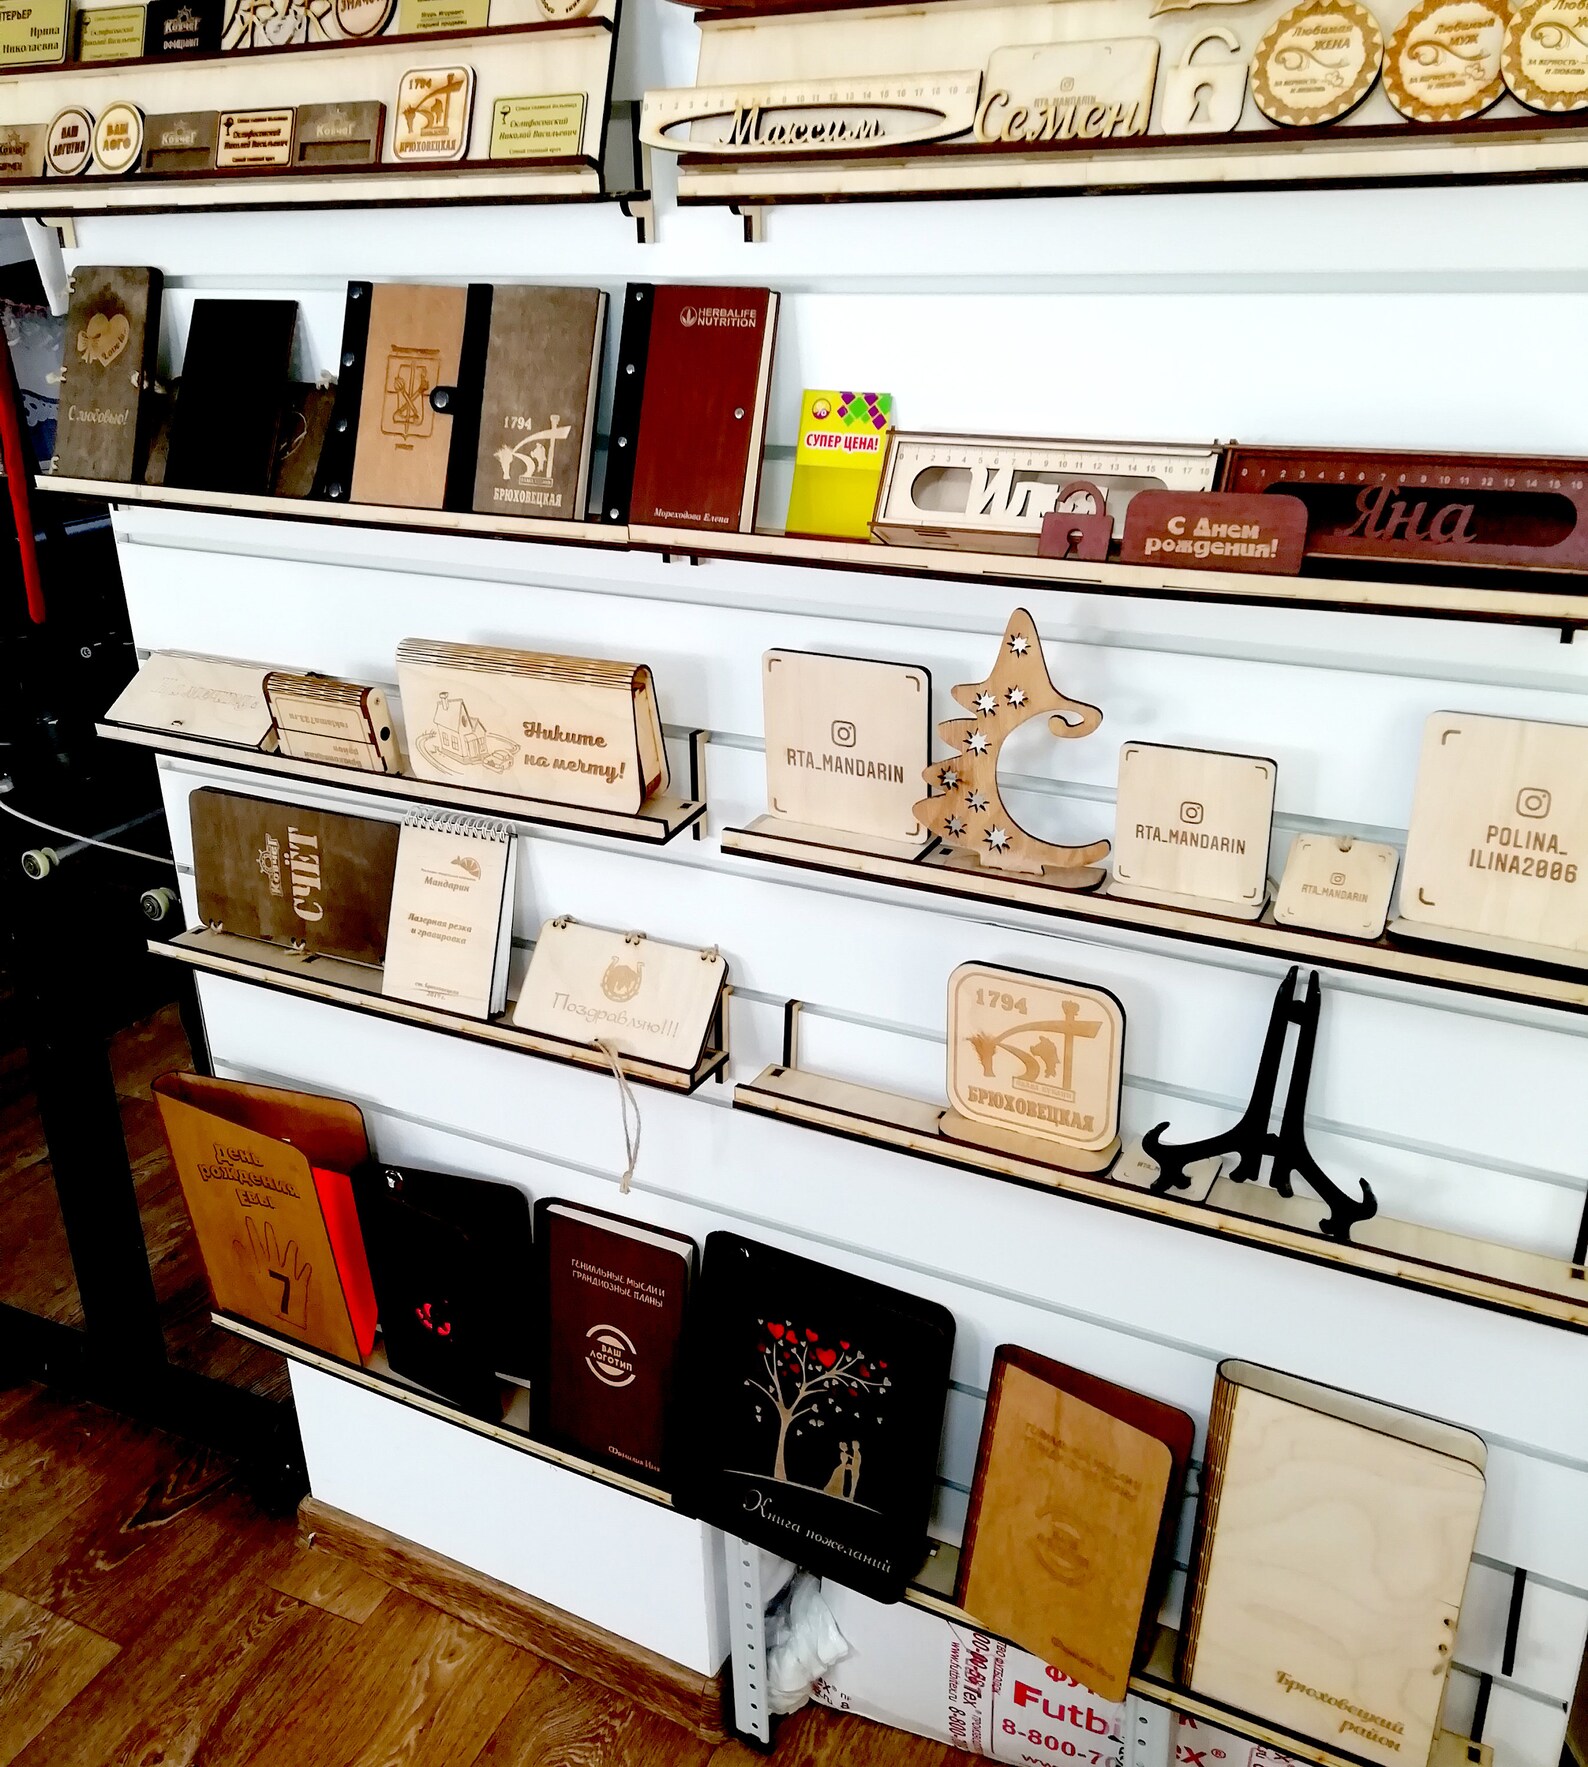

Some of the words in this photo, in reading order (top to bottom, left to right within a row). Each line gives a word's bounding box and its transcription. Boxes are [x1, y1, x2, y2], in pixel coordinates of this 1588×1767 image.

[30, 26, 60, 39] Ирина
[1312, 38, 1351, 51] ЖЕНА
[718, 103, 887, 147] Максим
[973, 89, 1150, 143] Семен
[61, 125, 79, 139] ВАШ
[109, 123, 130, 136] ВАШ
[53, 144, 86, 156] ЛОГОТИП
[103, 138, 132, 151] ЛОГО
[697, 317, 757, 328] NUTRITION
[698, 307, 757, 319] HERBALIFE
[504, 415, 533, 431] 1794
[806, 433, 842, 448] СУПЕР
[843, 436, 879, 452] ЦЕНА!
[493, 488, 563, 508] БРЮХОВЕЦКАЯ
[1167, 515, 1186, 536] С
[1193, 516, 1260, 540] Днем
[1334, 484, 1477, 546] Яна
[1144, 538, 1280, 559] рождения!
[522, 720, 610, 749] Никите
[524, 760, 553, 778] на
[552, 760, 628, 785] мечту!
[786, 747, 905, 784] RTA_MANDARIN
[1135, 823, 1247, 856] RTA_MANDARIN
[1486, 824, 1569, 856] POLINA_
[1468, 848, 1579, 884] ILINA2006
[424, 875, 471, 893] Мандарин
[1301, 883, 1369, 903] RTA_MANDARIN
[407, 912, 448, 928] Лазерная
[448, 922, 473, 933] резка
[417, 929, 468, 945] гравировка
[976, 988, 1029, 1016] 1794
[552, 991, 681, 1039] Поздравляю!!!
[967, 1084, 1096, 1133] БРЮХОВЕЦКАЯ
[571, 1258, 626, 1284] ГЕНИАЛЬНЫЕ
[626, 1277, 658, 1294] МЫСЛИ
[572, 1269, 633, 1298] ГРАНДИОЗНЫЕ
[633, 1290, 664, 1308] ПЛАНЫ
[268, 1269, 291, 1314] 7
[590, 1349, 633, 1372] ЛОГОТИП
[601, 1344, 622, 1358] ВАШ
[742, 1489, 801, 1534] Книга
[805, 1529, 893, 1573] пожеланий
[1277, 1670, 1404, 1736] Брюховецкий
[1339, 1720, 1401, 1751] район
